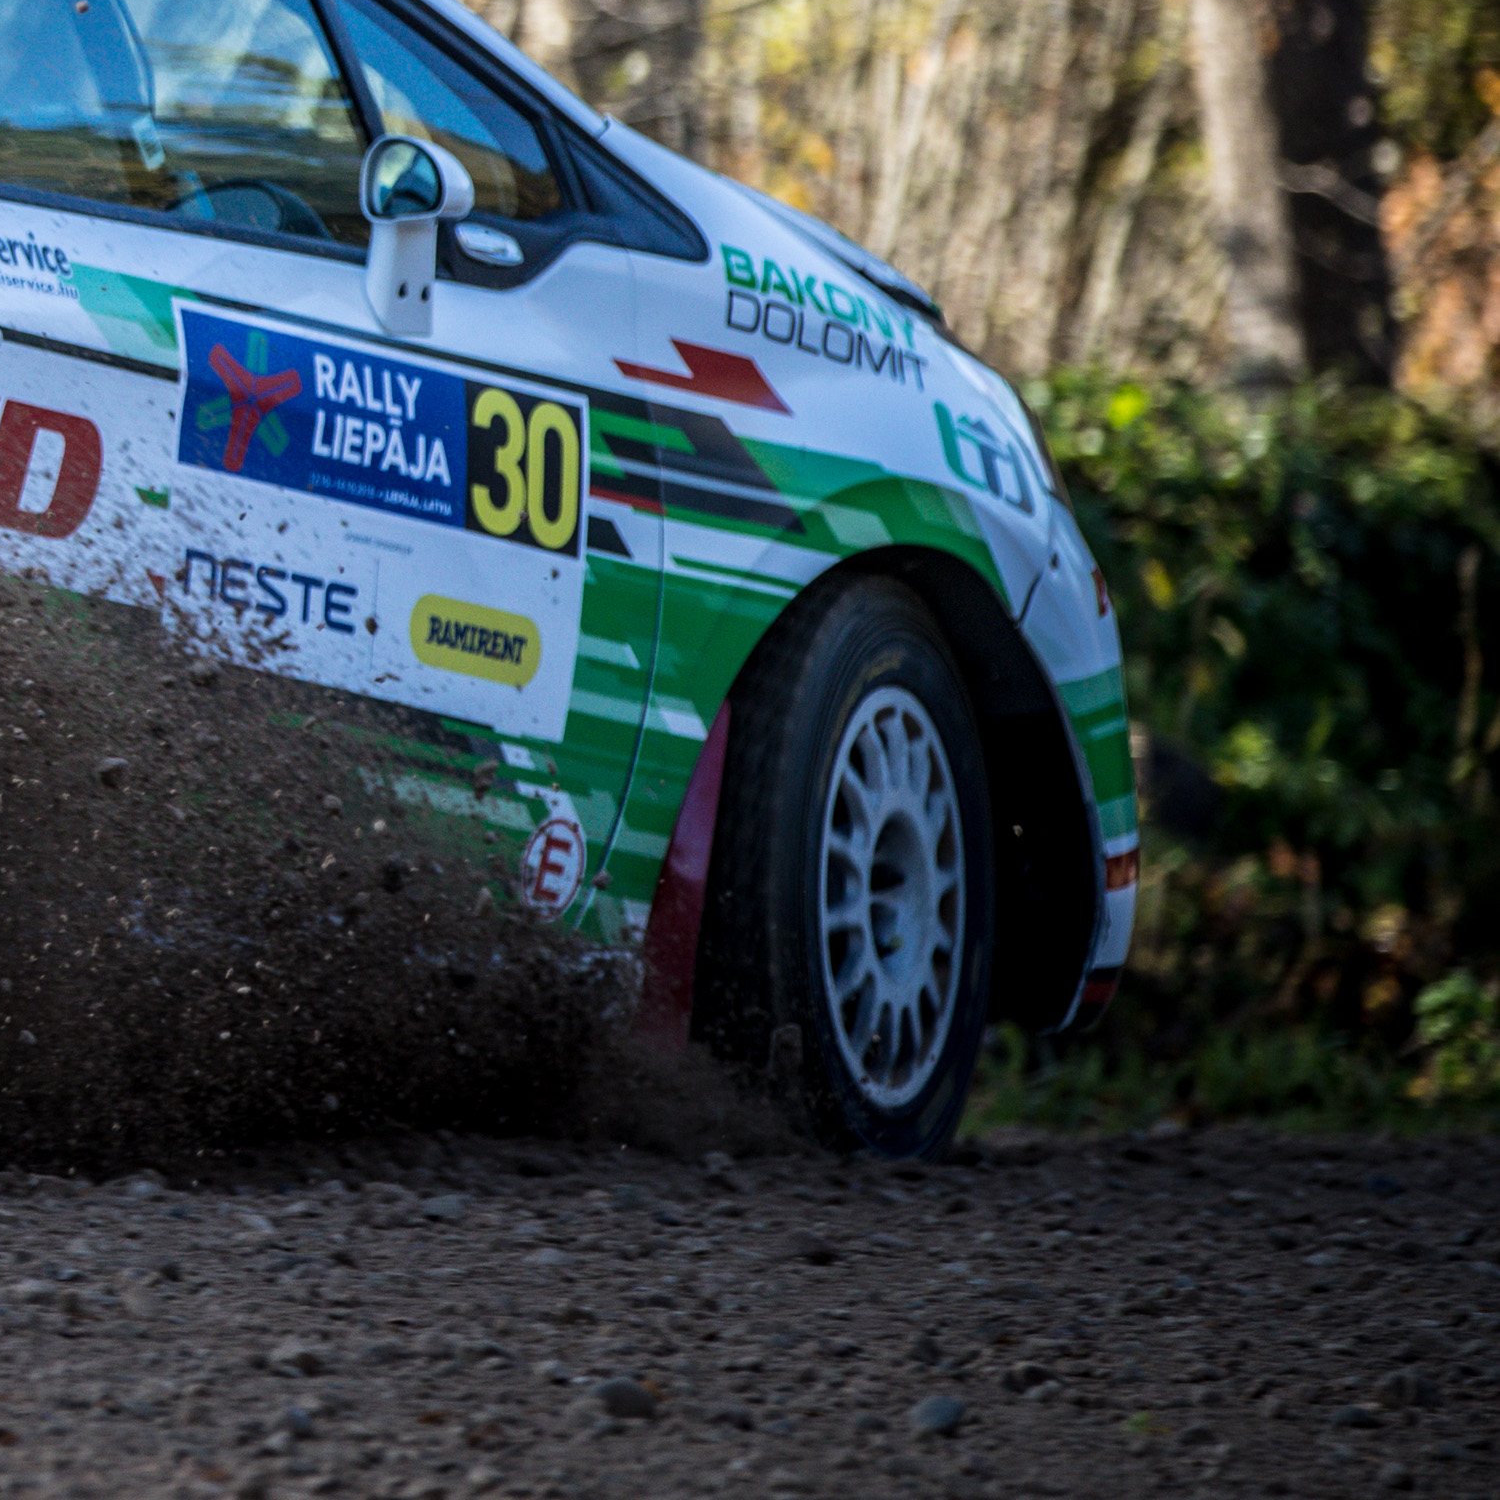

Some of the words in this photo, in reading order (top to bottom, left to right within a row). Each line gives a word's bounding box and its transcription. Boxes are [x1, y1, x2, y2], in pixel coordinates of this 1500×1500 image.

[720, 243, 914, 349] BAKONY
[727, 289, 929, 393] DOLOMIT
[313, 353, 421, 421] RALLY
[470, 387, 580, 550] 30
[182, 548, 359, 636] NESTE
[425, 614, 528, 666] RAMIRENT
[533, 835, 573, 902] E
